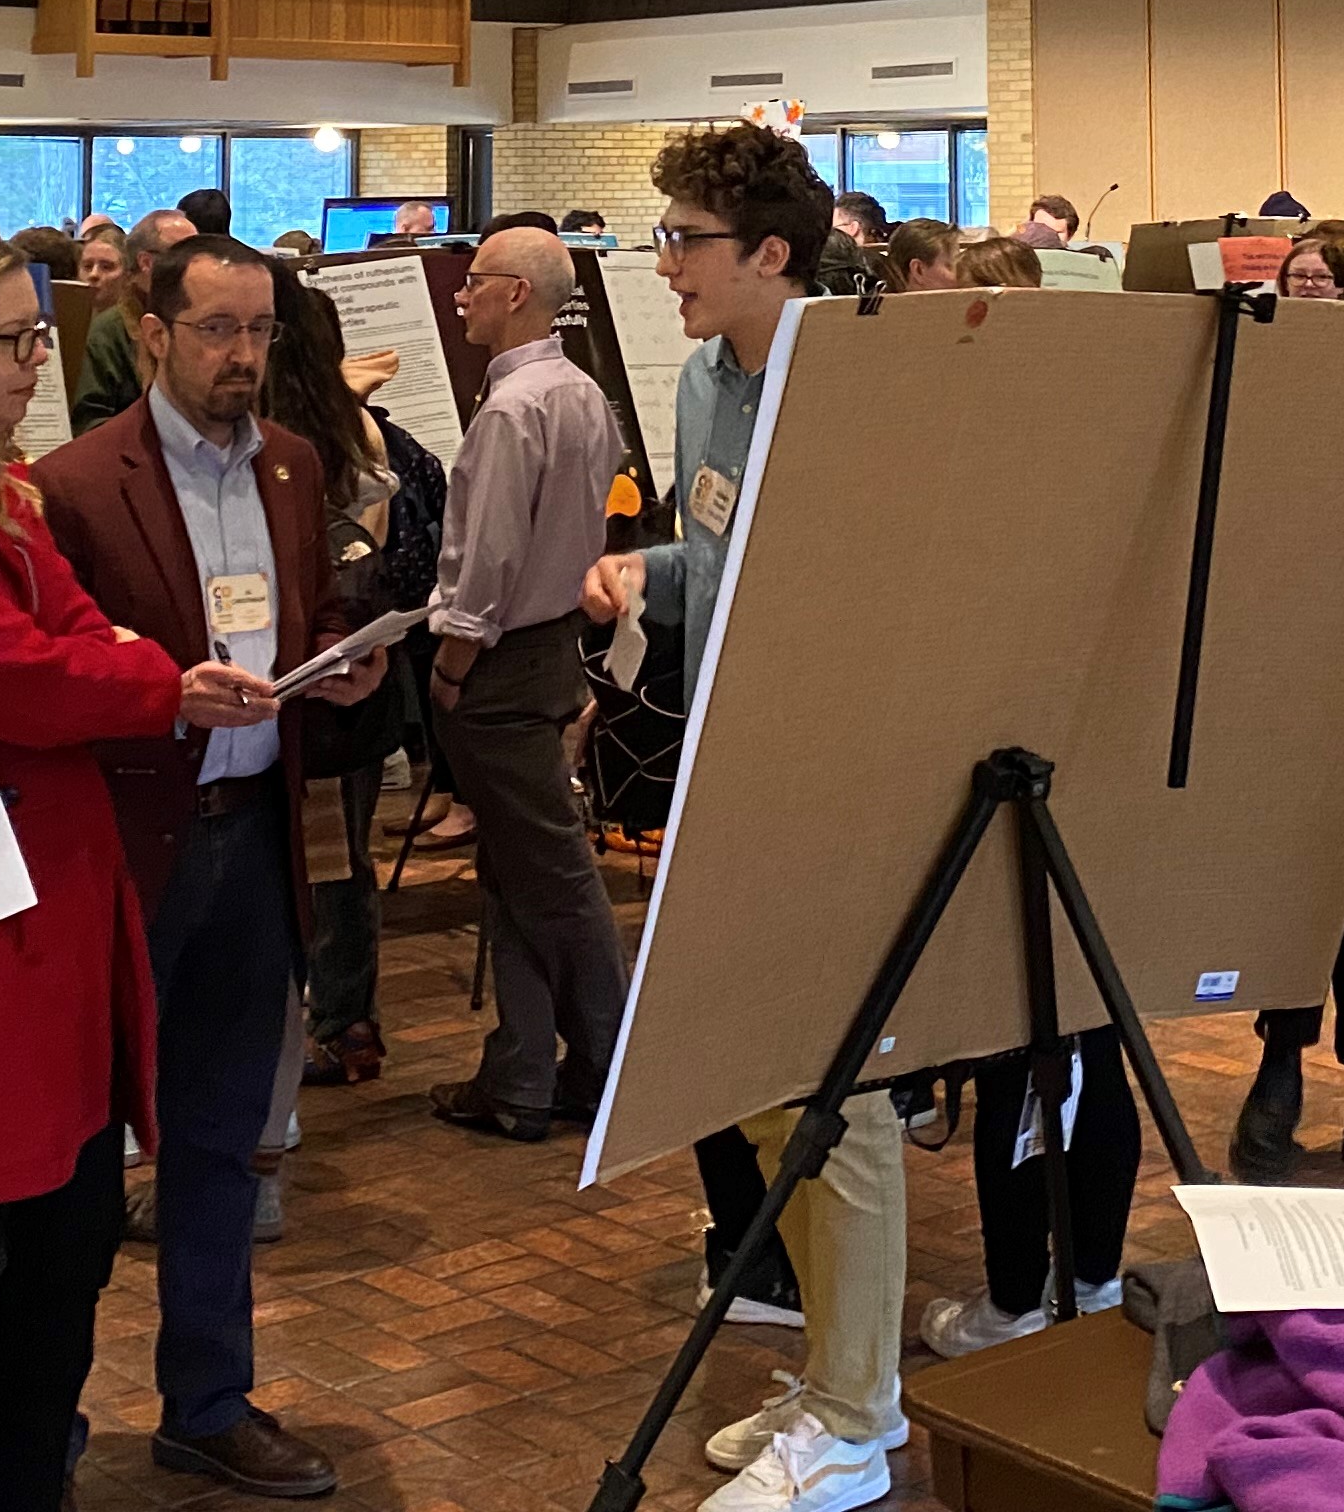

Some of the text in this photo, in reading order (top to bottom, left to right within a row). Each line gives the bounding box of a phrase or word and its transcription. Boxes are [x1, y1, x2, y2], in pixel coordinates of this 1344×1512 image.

[306, 273, 352, 286] Synthesis
[354, 271, 364, 280] of
[340, 279, 396, 292] compounds
[398, 275, 417, 285] with
